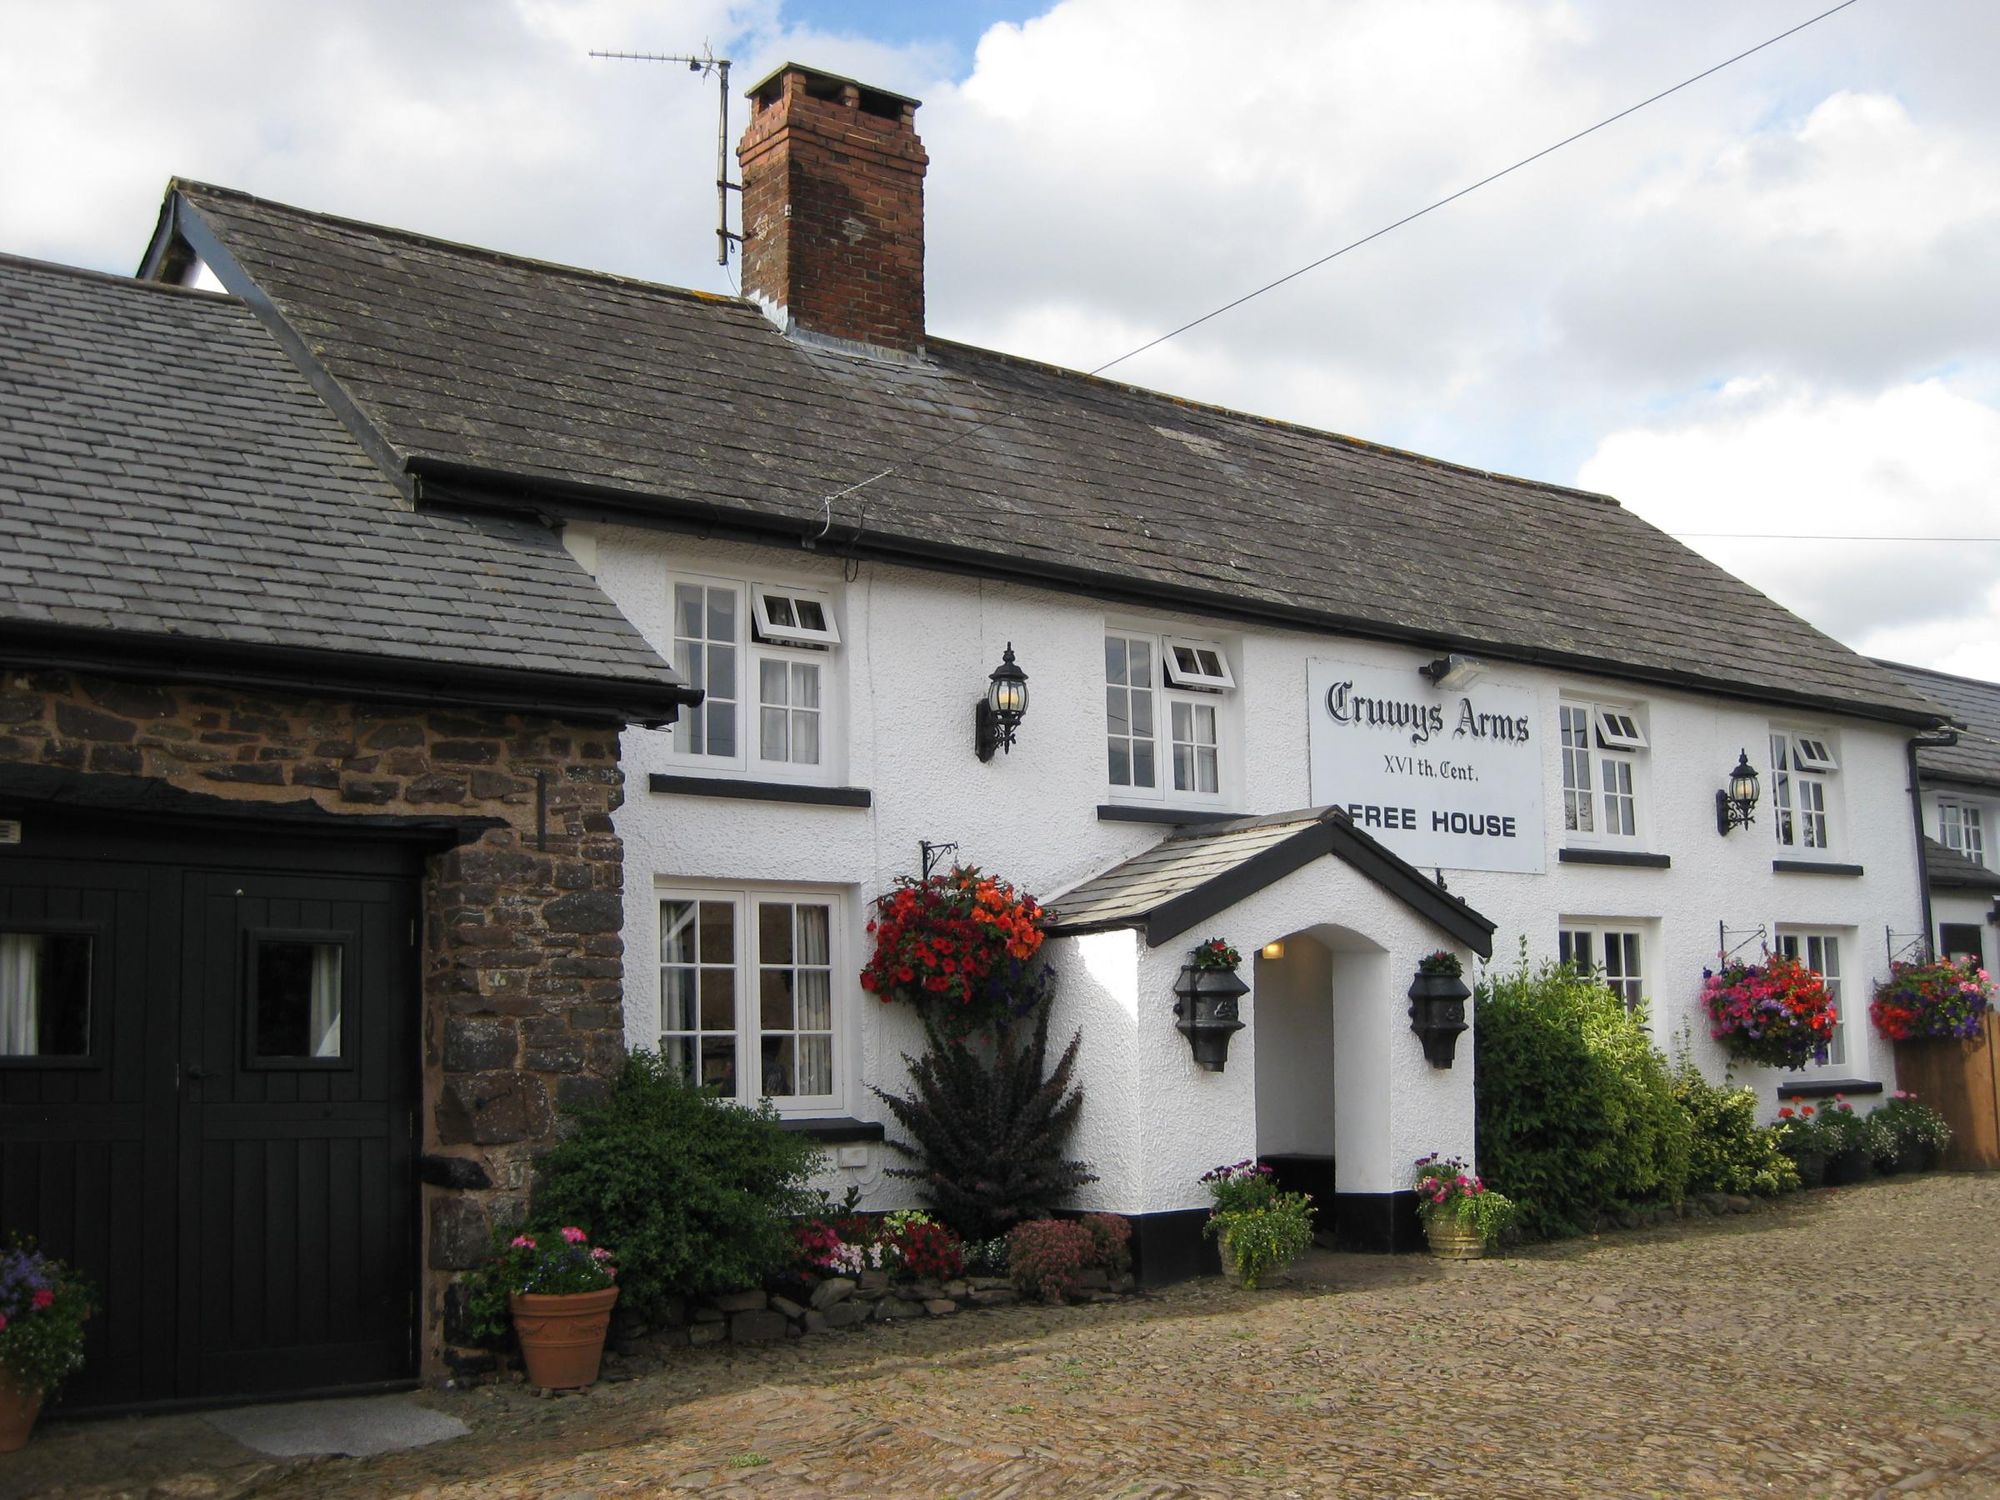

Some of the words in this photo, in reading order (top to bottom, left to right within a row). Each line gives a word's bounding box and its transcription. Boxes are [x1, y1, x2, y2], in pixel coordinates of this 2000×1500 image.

[1326, 680, 1443, 744] Cruwys
[1455, 698, 1530, 742] Arms
[1349, 803, 1417, 830] FREE
[1432, 811, 1516, 837] HOUSE
